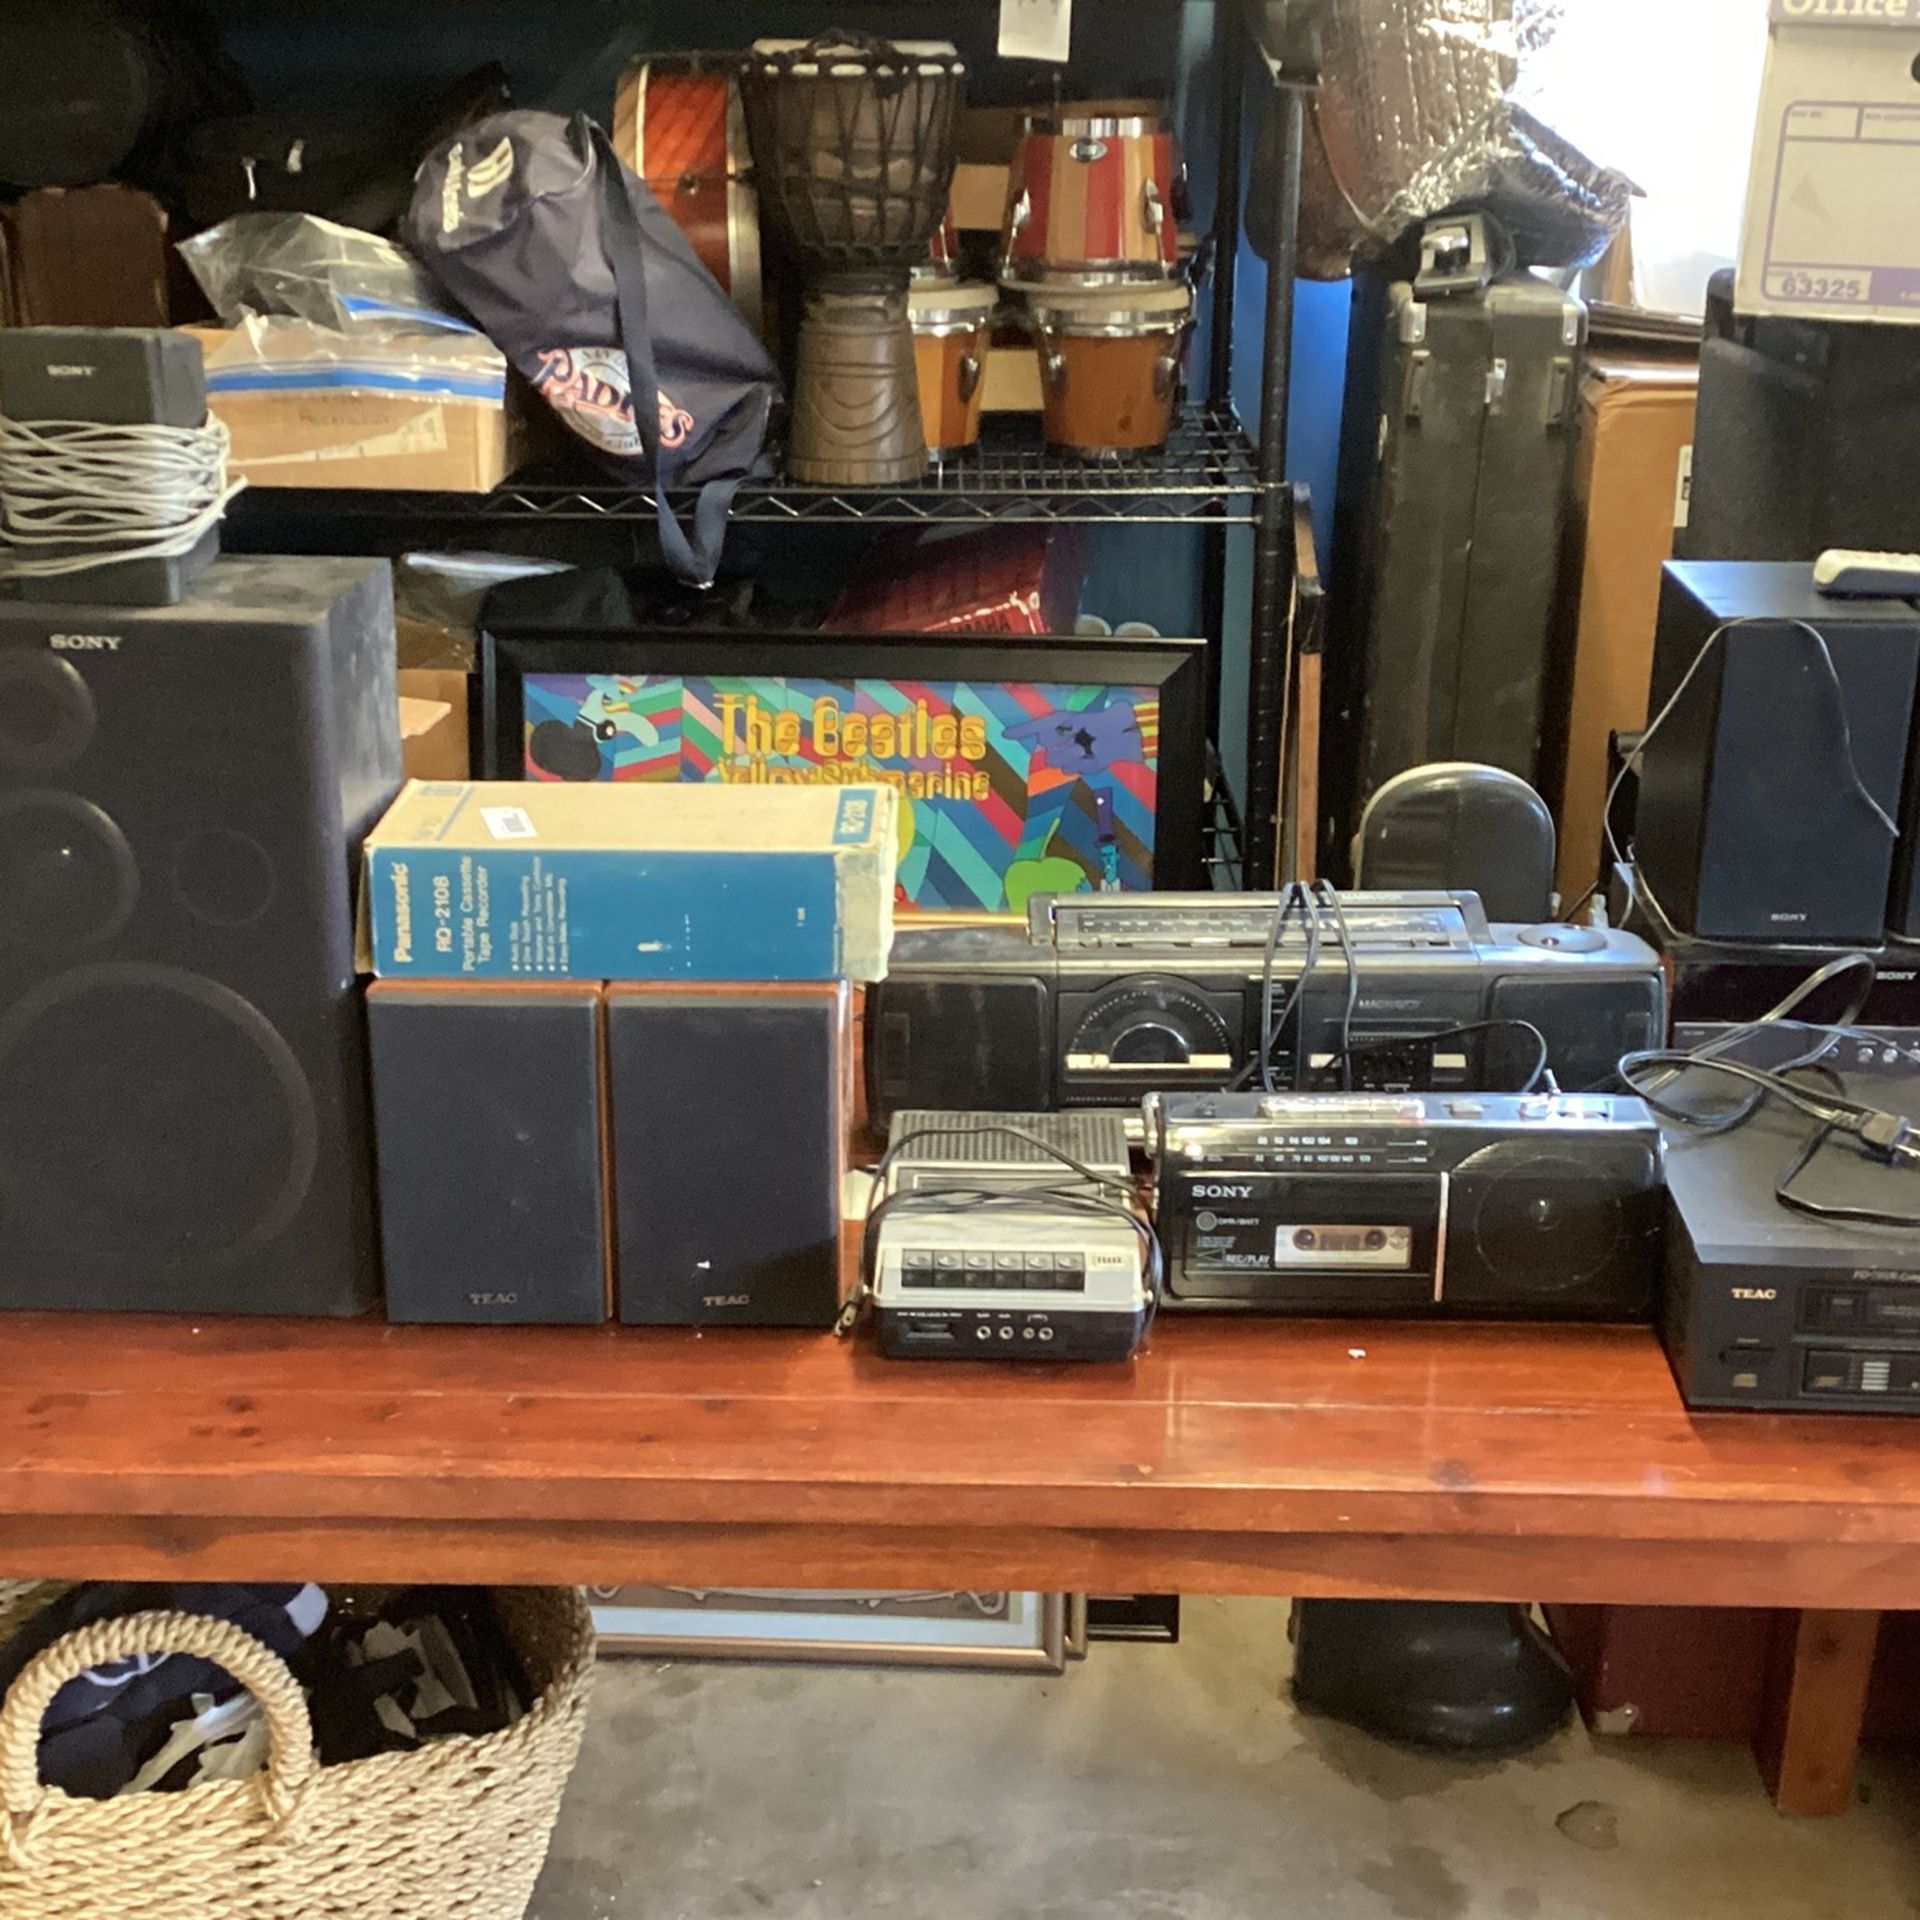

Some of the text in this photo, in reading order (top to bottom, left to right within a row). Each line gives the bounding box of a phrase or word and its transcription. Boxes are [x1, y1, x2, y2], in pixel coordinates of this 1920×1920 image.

[1781, 278, 1861, 298] 63325
[46, 364, 97, 377] SONY
[531, 349, 694, 448] PADS
[49, 633, 121, 650] SONY
[713, 693, 987, 761] The Beatles
[390, 862, 413, 963] Panasonic
[460, 856, 475, 971] Portable Cassette
[476, 865, 492, 963] Tape Recorder
[1770, 912, 1808, 922] SONY
[1875, 971, 1917, 980] SONY
[1191, 1184, 1253, 1198] SONY
[1225, 1254, 1270, 1264] REC/PLAY
[469, 1293, 518, 1305] TEAC
[702, 1295, 750, 1307] TEAC
[1731, 1288, 1777, 1300] TEAC
